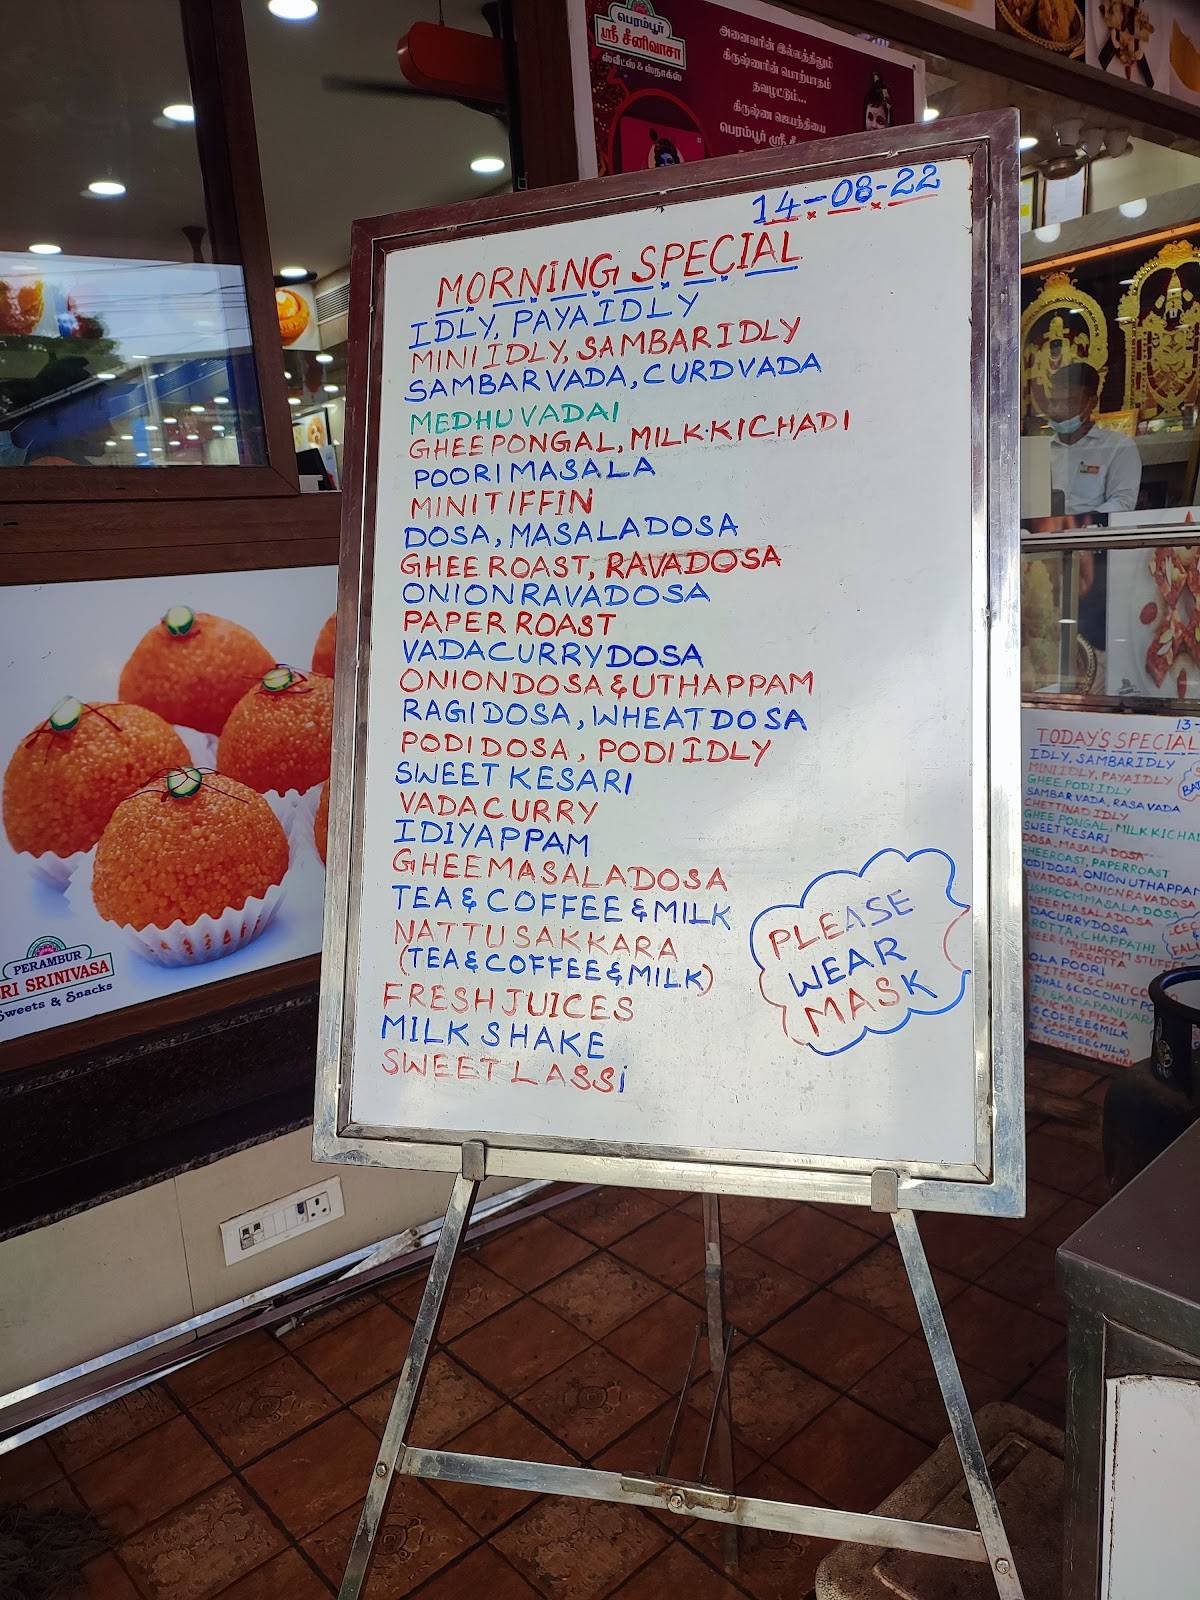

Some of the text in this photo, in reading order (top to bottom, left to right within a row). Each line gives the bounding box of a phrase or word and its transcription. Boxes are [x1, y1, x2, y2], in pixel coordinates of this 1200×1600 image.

[618, 12, 665, 36] பெரம்பூர்
[622, 28, 681, 61] சீனிவாசா
[752, 163, 941, 225] 14-08-22
[437, 229, 804, 308] MORNING SPECIAL
[408, 313, 500, 350] IDLY,
[404, 523, 502, 550] DOSA,
[1037, 728, 1200, 751] TODAY'S SPECIAL
[394, 760, 633, 797] SWEET KESARI
[392, 818, 590, 858] IDIYAPPAM
[768, 888, 914, 961] PLEASE
[0, 959, 110, 999] RI SRINIVASA
[13, 950, 82, 975] PERAMBUR
[787, 936, 908, 998] WEAR
[50, 997, 61, 1007] &
[66, 983, 113, 1003] Snacks
[803, 969, 938, 1038] MASK
